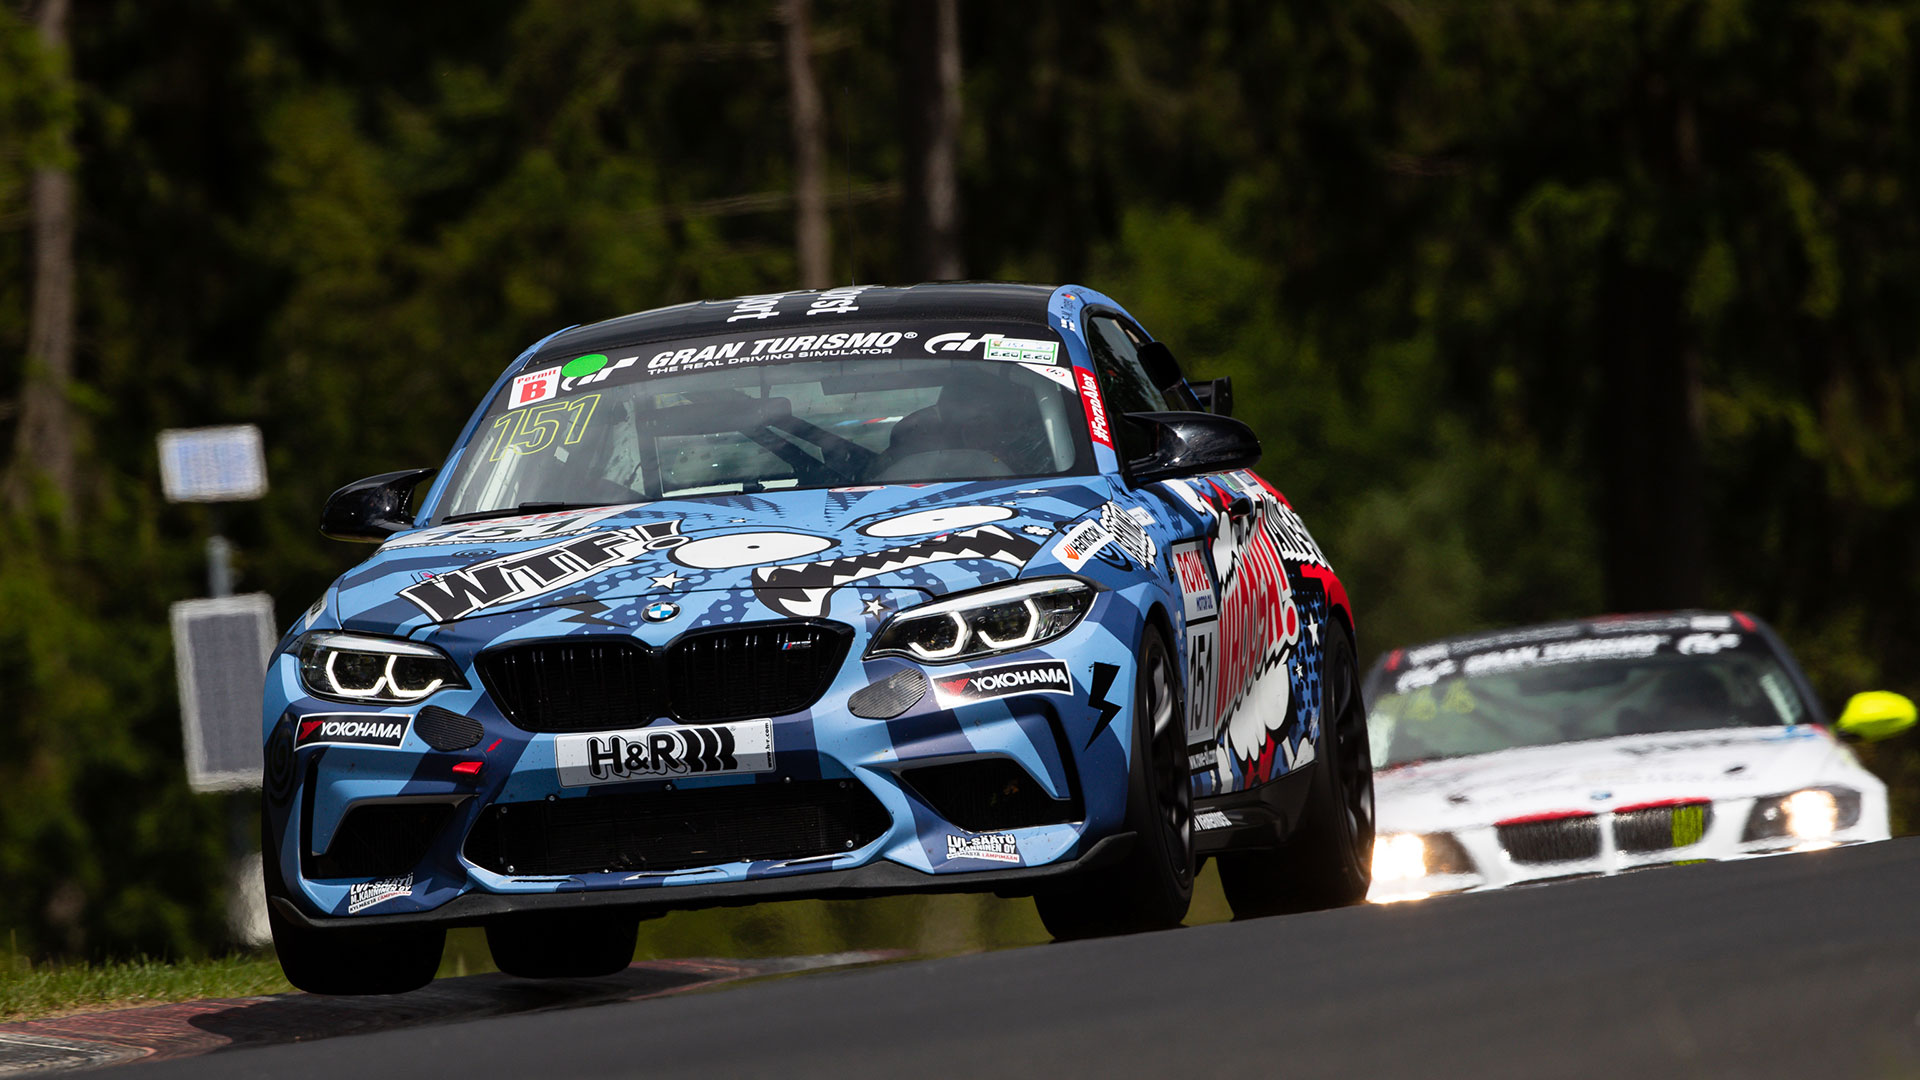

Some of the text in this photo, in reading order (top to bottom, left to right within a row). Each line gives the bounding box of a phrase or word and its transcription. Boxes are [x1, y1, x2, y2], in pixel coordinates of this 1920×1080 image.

[648, 342, 745, 369] GRAN
[648, 348, 892, 376] THE REAL DRIVING SIMULATOR
[517, 369, 557, 384] Permit
[520, 379, 547, 403] B
[1081, 373, 1110, 443] #ForzaAlex
[489, 394, 601, 461] 151
[426, 516, 586, 541] 151
[400, 519, 692, 622] WTF!
[1176, 549, 1210, 594] ROWE
[970, 668, 1068, 692] YOKOHAMA
[1190, 633, 1213, 732] 151
[320, 720, 401, 739] YOKOHAMA
[588, 731, 683, 777] H&R
[1003, 844, 1016, 854] OY
